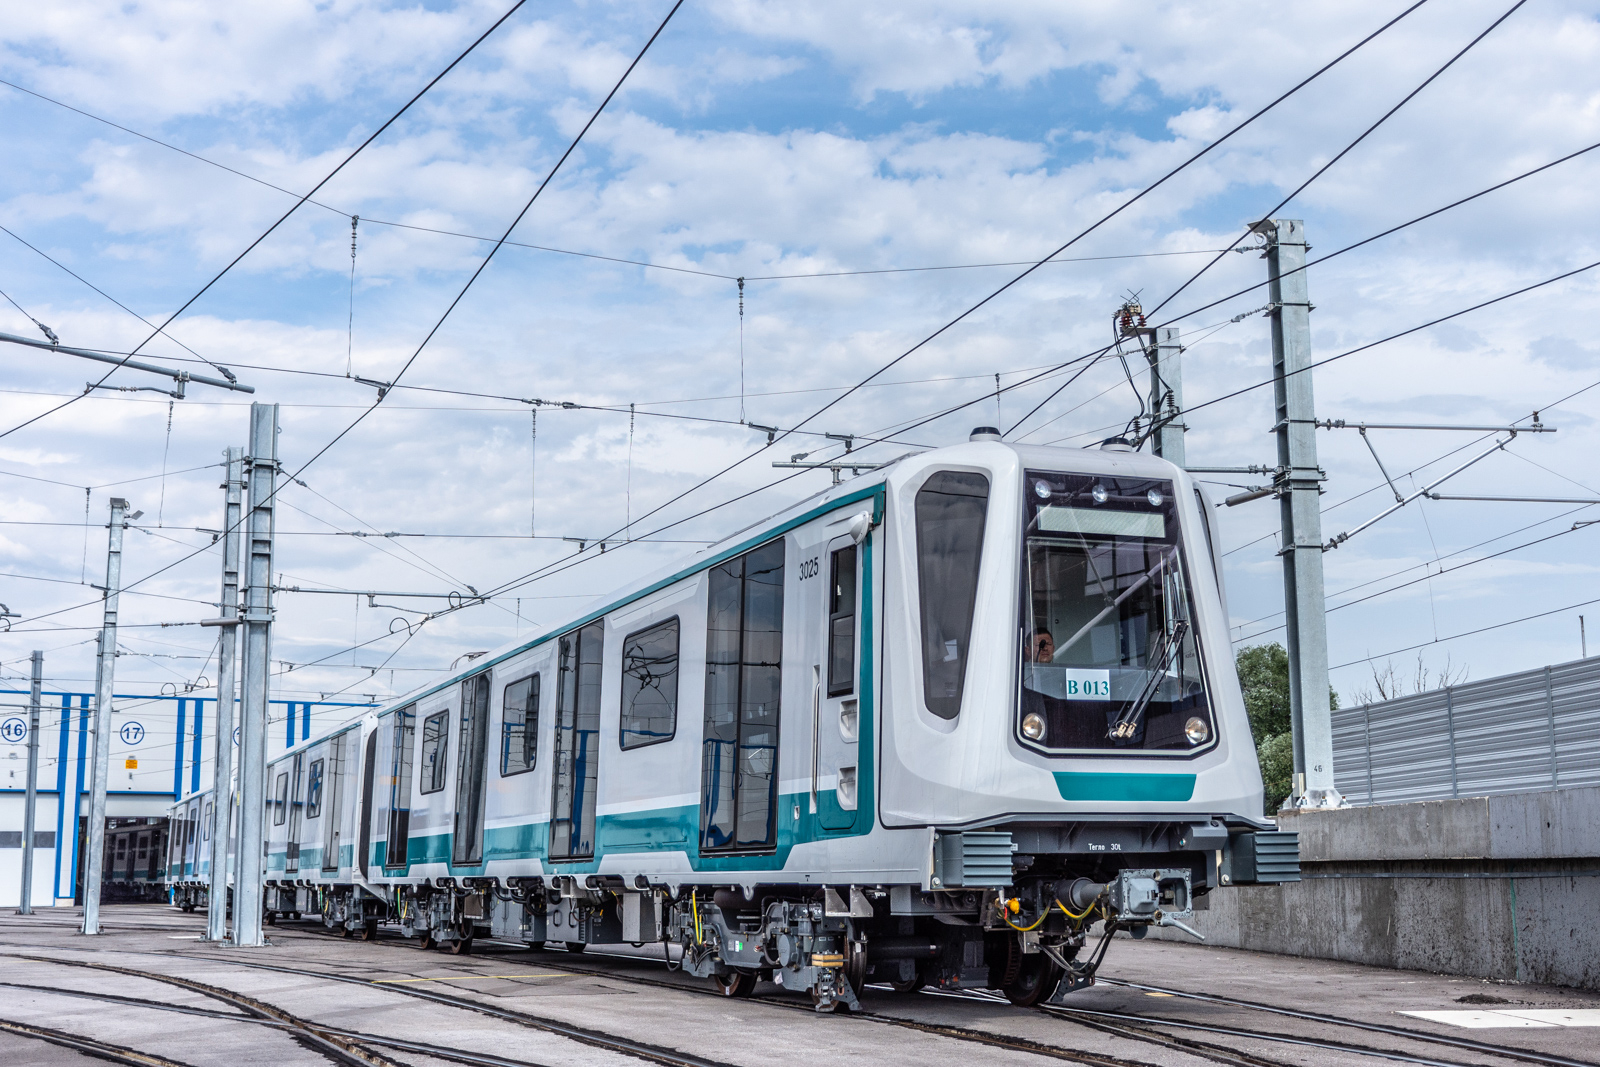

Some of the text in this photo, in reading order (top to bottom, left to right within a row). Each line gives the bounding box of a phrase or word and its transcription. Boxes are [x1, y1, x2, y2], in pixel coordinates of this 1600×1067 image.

[799, 556, 818, 581] 3025
[1083, 680, 1109, 696] 013
[5, 724, 23, 737] 16
[124, 727, 140, 740] 17
